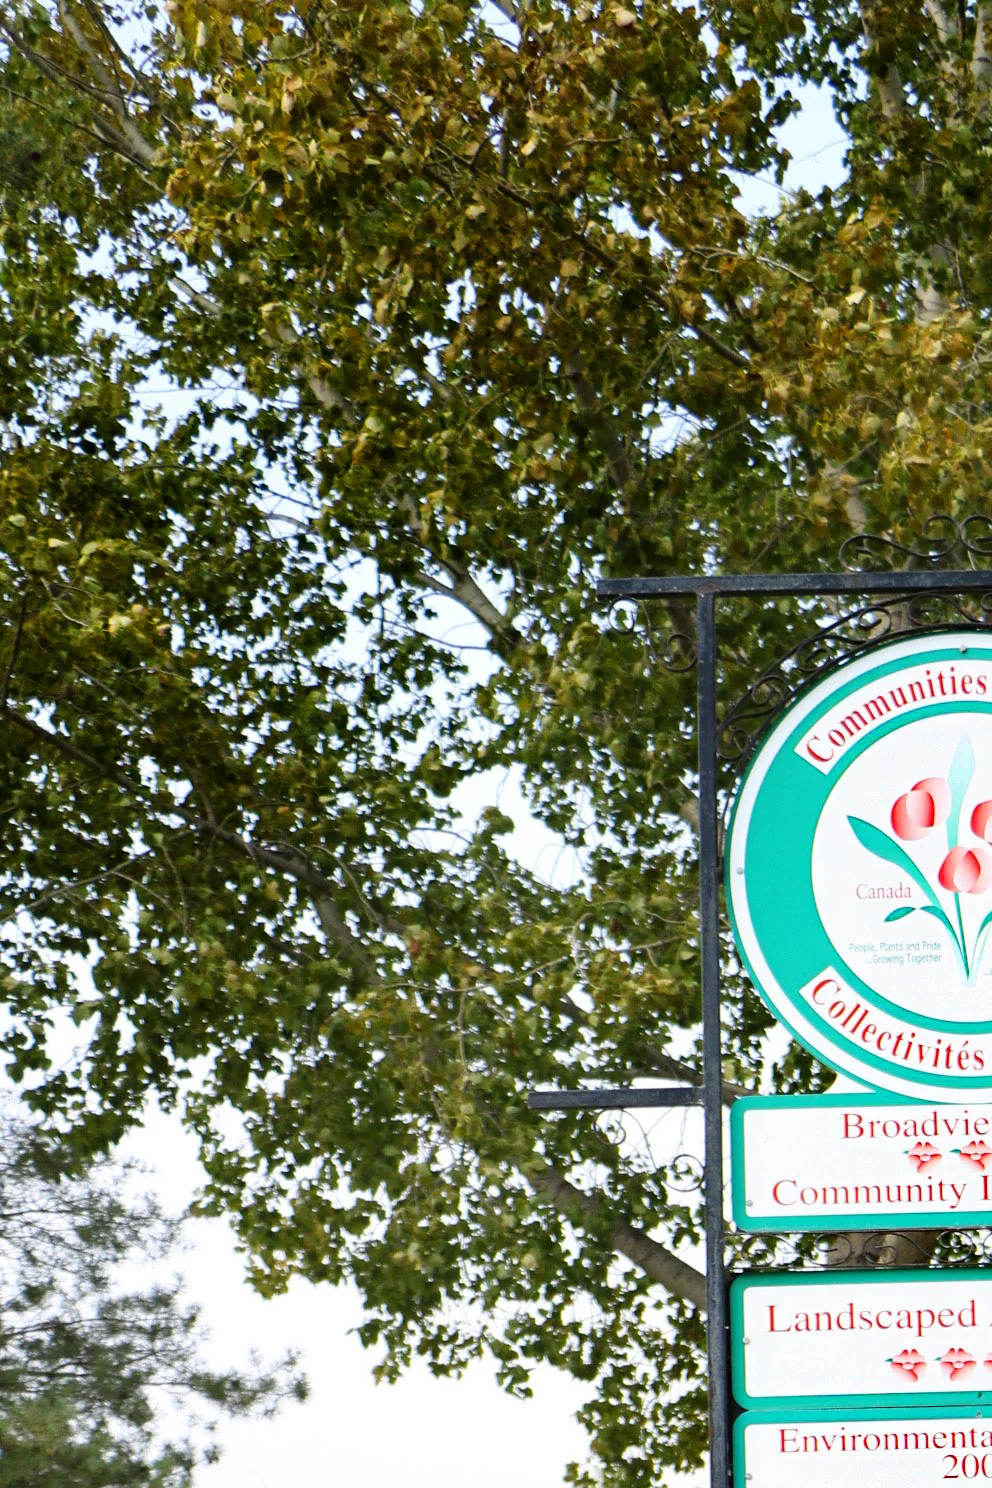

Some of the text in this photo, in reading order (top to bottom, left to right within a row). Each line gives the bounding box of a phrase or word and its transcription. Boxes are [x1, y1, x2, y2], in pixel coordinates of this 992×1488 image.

[806, 668, 987, 762] Communities
[856, 883, 911, 899] Canada
[849, 941, 941, 953] People, Plants and Pride
[906, 953, 942, 964] Together
[812, 979, 984, 1071] Collectivités
[772, 1175, 967, 1209] Community
[767, 1300, 976, 1337] Landscaped
